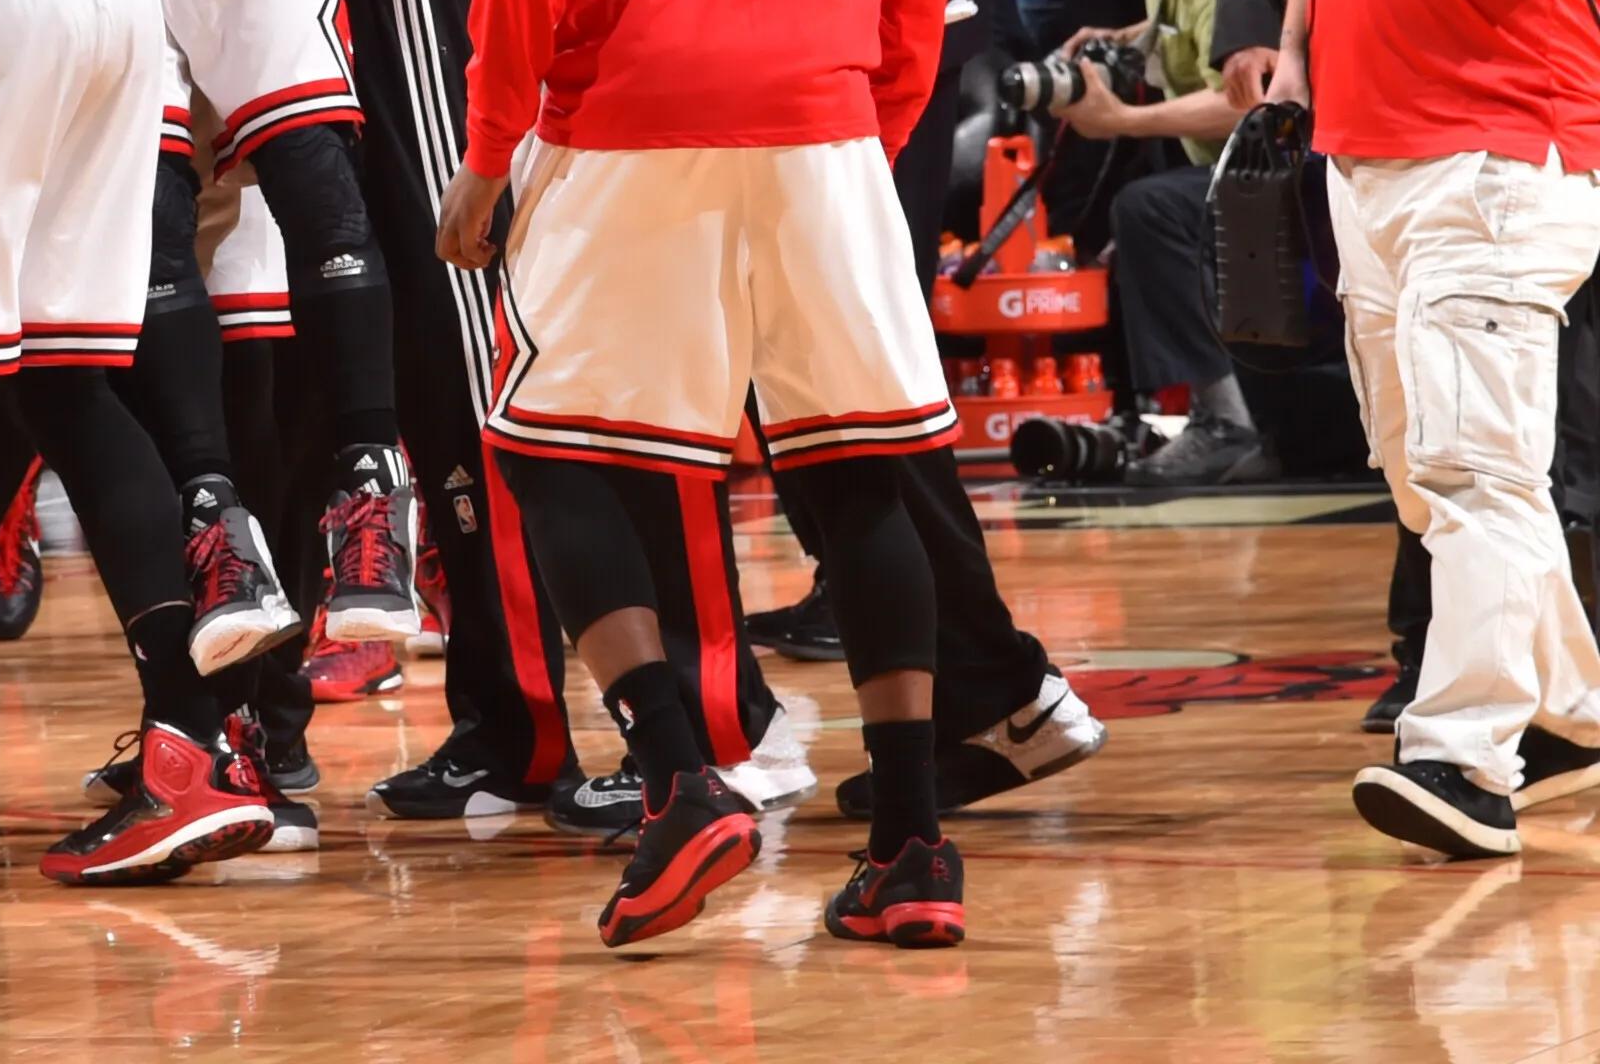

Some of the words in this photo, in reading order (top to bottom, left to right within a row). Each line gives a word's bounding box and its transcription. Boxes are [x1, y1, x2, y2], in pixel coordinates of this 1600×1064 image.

[998, 289, 1024, 318] G
[1026, 294, 1081, 314] PRIME
[985, 413, 1010, 440] G
